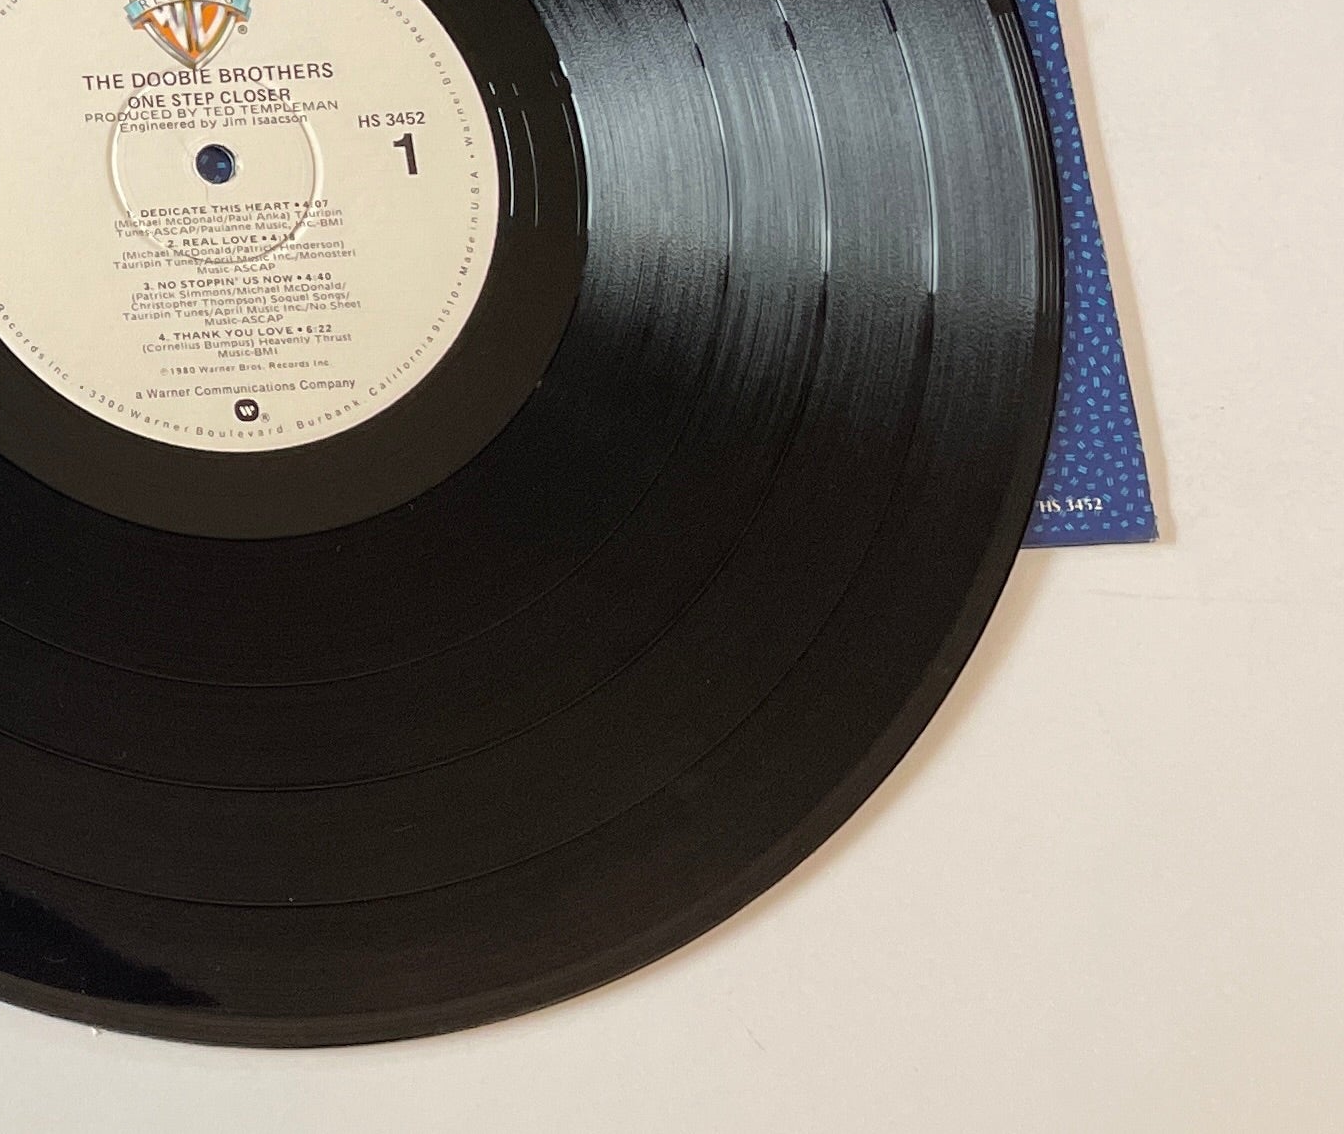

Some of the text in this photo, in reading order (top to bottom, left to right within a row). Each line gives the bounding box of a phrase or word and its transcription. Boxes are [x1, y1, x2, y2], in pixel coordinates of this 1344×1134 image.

[82, 62, 334, 90] THE DOOBIE BROTHERS
[128, 88, 291, 109] ONE STEP CLOSER
[85, 100, 339, 123] PRODUCED BY TED TEMPLEMAN
[357, 111, 426, 128] HS 3452
[120, 114, 308, 133] Engineered by Jim Isaacson
[393, 133, 418, 175] 1
[114, 209, 343, 229] (Michael McDonald/Paul Anka) Tauripin
[140, 205, 207, 218] DEDICATE
[211, 204, 242, 214] THIS
[245, 201, 290, 212] HEART
[255, 220, 292, 230] Music,
[122, 250, 169, 261] (Michael
[280, 240, 345, 251] Henderson)
[182, 237, 218, 247] REAL
[223, 235, 258, 245] LOVE
[113, 260, 162, 270] Tauripin
[132, 282, 347, 302] (Patrick Simmons/Michael McDonald/
[157, 281, 177, 290] NO
[180, 277, 238, 288] STOPPIN'
[242, 276, 259, 285] US
[263, 274, 293, 284] NOW
[122, 311, 171, 321] Tauripin
[174, 306, 243, 318] Tunes/April
[246, 305, 280, 314] Music
[330, 300, 362, 311] Sheet
[131, 292, 350, 312] Christopher Thompson) Soquel Songs/
[142, 333, 353, 354] (Cornelius Bumpus) Heavenly Thrust
[173, 330, 221, 341] THANK
[224, 328, 253, 338] YOU
[258, 326, 294, 336] LOVE
[199, 364, 235, 374] Warner
[268, 360, 310, 369] Records
[135, 378, 356, 400] a Warner Communications Company
[1040, 496, 1104, 513] HS 3452
